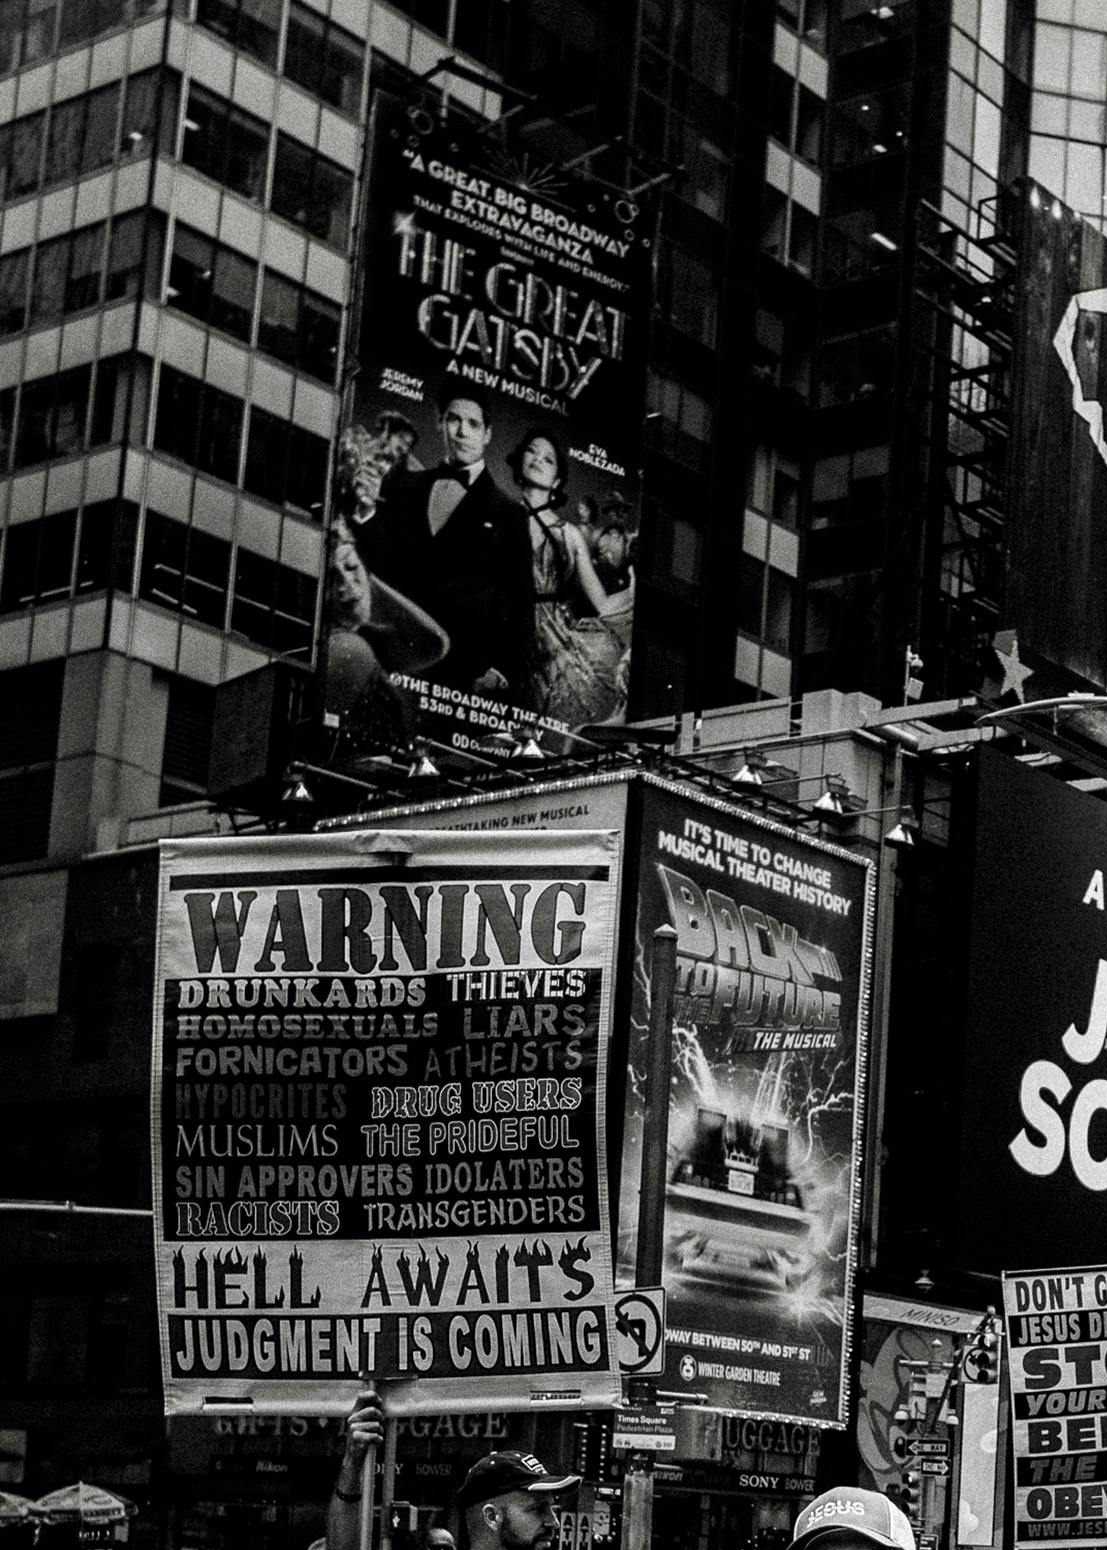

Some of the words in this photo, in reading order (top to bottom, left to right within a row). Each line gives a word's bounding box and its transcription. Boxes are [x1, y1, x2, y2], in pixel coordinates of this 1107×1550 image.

[450, 190, 594, 264] EXTRAVAGANZA
[495, 187, 527, 216] BIG
[530, 203, 631, 258] BROADWAY
[394, 212, 476, 300] THE
[486, 262, 628, 360] GREAT
[417, 295, 602, 399] GATSBY
[447, 359, 460, 375] A
[462, 364, 500, 388] NEW
[501, 376, 570, 416] MUSICAL
[401, 677, 428, 695] THE
[431, 684, 509, 717] BROADWAY
[510, 706, 570, 733] THEATRE
[419, 696, 453, 716] 53RD
[511, 811, 538, 828] NEW
[540, 803, 590, 822] MUSICAL
[658, 830, 726, 873] MUSICAL
[726, 853, 791, 898] THEATER
[792, 882, 852, 917] HISTORY
[684, 818, 713, 844] IT'S
[714, 828, 749, 859] TIME
[750, 842, 772, 866] TO
[773, 851, 832, 889] CHANGE
[1082, 869, 1105, 911] A
[183, 881, 588, 976] WARNING
[655, 861, 845, 986] BACK
[177, 976, 427, 1009] DRUNKARDS
[446, 968, 587, 1003] THIEVES
[175, 1012, 440, 1041] HOMOSEXUALS
[463, 1003, 587, 1040] LIARS
[752, 1030, 782, 1051] THE
[782, 1030, 838, 1051] MUSICAL
[175, 1044, 409, 1079] FORNICATORS
[424, 1039, 584, 1082] ATHEISTS
[175, 1082, 348, 1120] HYPOCRITES
[371, 1083, 462, 1119] DRUG
[472, 1077, 584, 1114] USERS
[174, 1123, 339, 1158] MUSLIMS
[361, 1123, 421, 1158] THE
[428, 1114, 580, 1154] PRIDEFUL
[174, 1164, 226, 1200] SIN
[237, 1162, 414, 1199] APPROVERS
[424, 1156, 585, 1195] IDOLATERS
[175, 1200, 340, 1237] RACISTS
[363, 1193, 587, 1233] TRANSGENDERS
[172, 1243, 323, 1311] HELL
[361, 1234, 596, 1308] AWAITS
[1015, 1276, 1085, 1313] DON'T
[900, 1308, 961, 1327] MINISO
[1018, 1313, 1081, 1346] JESUS
[175, 1316, 383, 1373] JUDGMENT
[398, 1314, 435, 1373] IS
[448, 1309, 601, 1370] COMING
[692, 1334, 740, 1352] BETWEEN
[761, 1343, 782, 1357] AND
[798, 1347, 812, 1360] ST
[698, 1361, 725, 1379] WINTER
[725, 1364, 752, 1382] GARDEN
[752, 1367, 781, 1387] THEATRE
[618, 1414, 637, 1425] Times
[640, 1415, 667, 1426] Square
[1026, 1388, 1107, 1417] YOUR
[617, 1424, 652, 1433] Pedestrian
[654, 1426, 674, 1434] Plaza
[738, 1473, 780, 1489] SONY
[785, 1478, 815, 1492] BOWER
[1029, 1455, 1098, 1484] THE
[805, 1498, 866, 1528] JESUS
